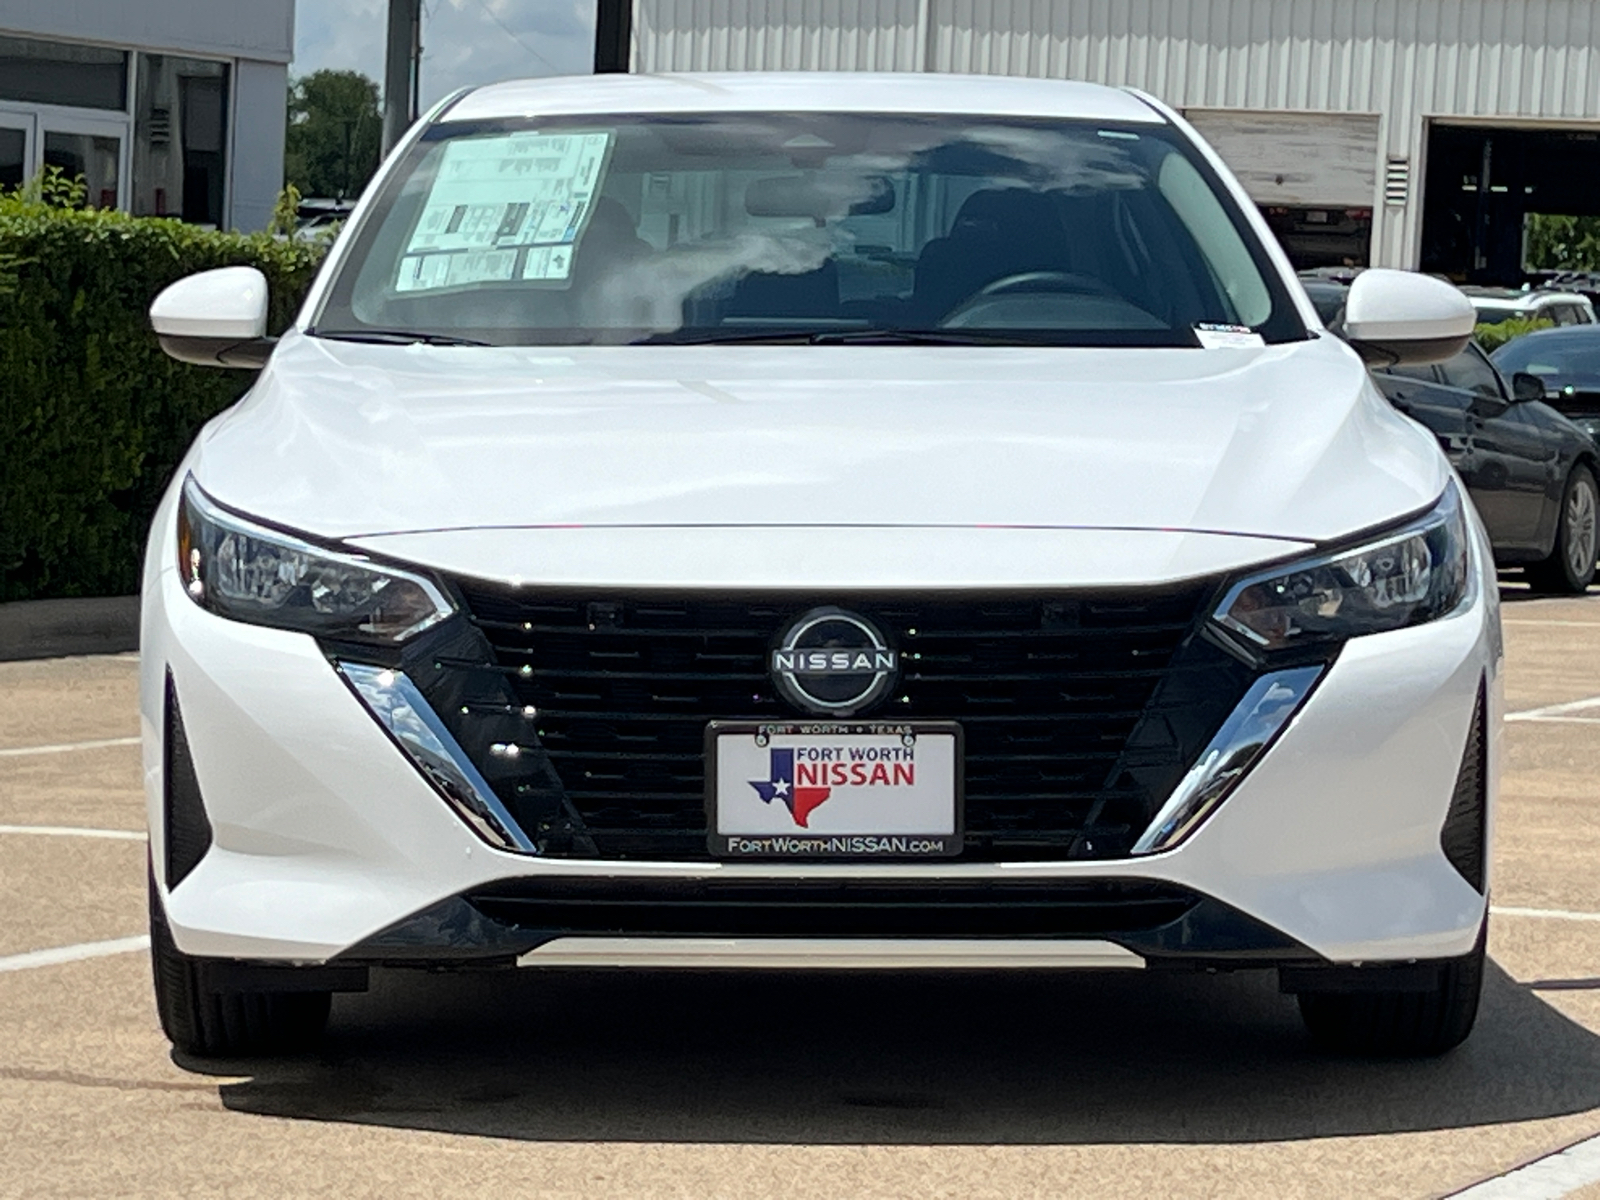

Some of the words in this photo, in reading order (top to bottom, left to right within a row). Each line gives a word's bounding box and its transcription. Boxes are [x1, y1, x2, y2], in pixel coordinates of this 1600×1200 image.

[776, 653, 894, 669] NISSAN
[758, 725, 794, 734] FORT
[800, 725, 849, 734] WORTH
[869, 725, 912, 734] TEXAS
[797, 748, 844, 761] FORT
[850, 748, 914, 761] WORTH
[797, 764, 914, 786] NISSAN
